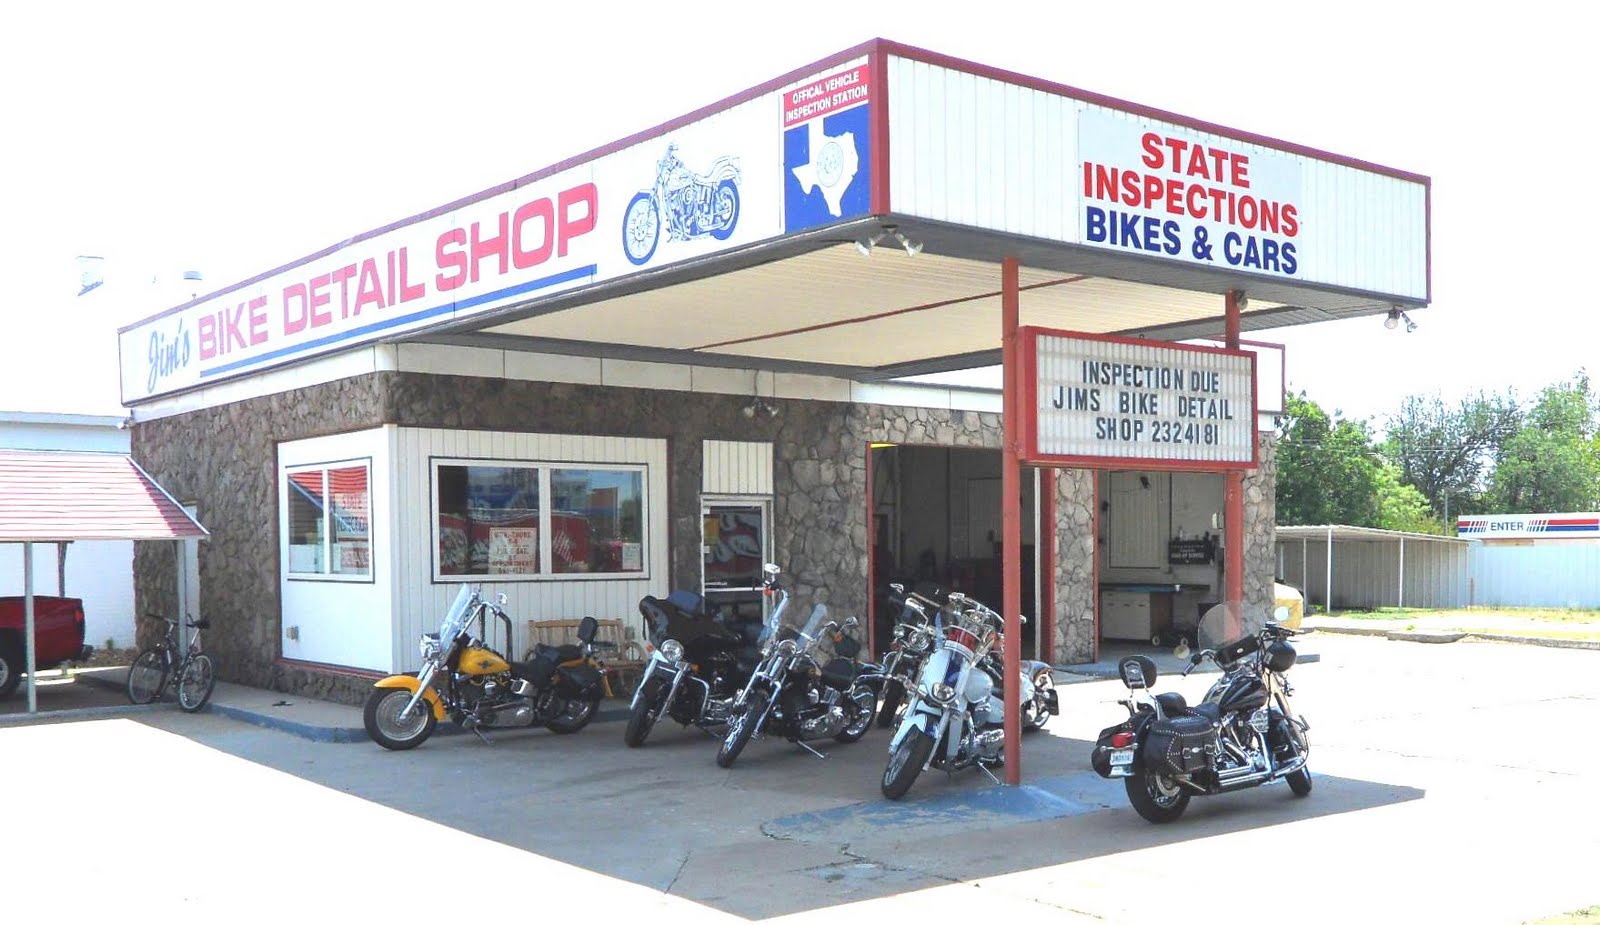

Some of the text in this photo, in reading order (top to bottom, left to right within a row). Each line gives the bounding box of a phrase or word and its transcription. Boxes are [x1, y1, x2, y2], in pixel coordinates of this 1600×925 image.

[786, 84, 868, 123] INSPECTION STATION
[792, 71, 860, 105] OFFICAL VEHICLE
[1141, 132, 1250, 189] STATE
[1083, 161, 1298, 238] INSPECTIONS
[1086, 205, 1298, 275] BIKES & CARS
[146, 182, 599, 393] Jim's BIKE DETAIL SHOP
[1082, 360, 1220, 394] INSPECTION DUE
[1053, 386, 1233, 420] JIMS BIKE DETAIL
[1096, 417, 1144, 441] SHOP
[1490, 521, 1524, 532] ENTER
